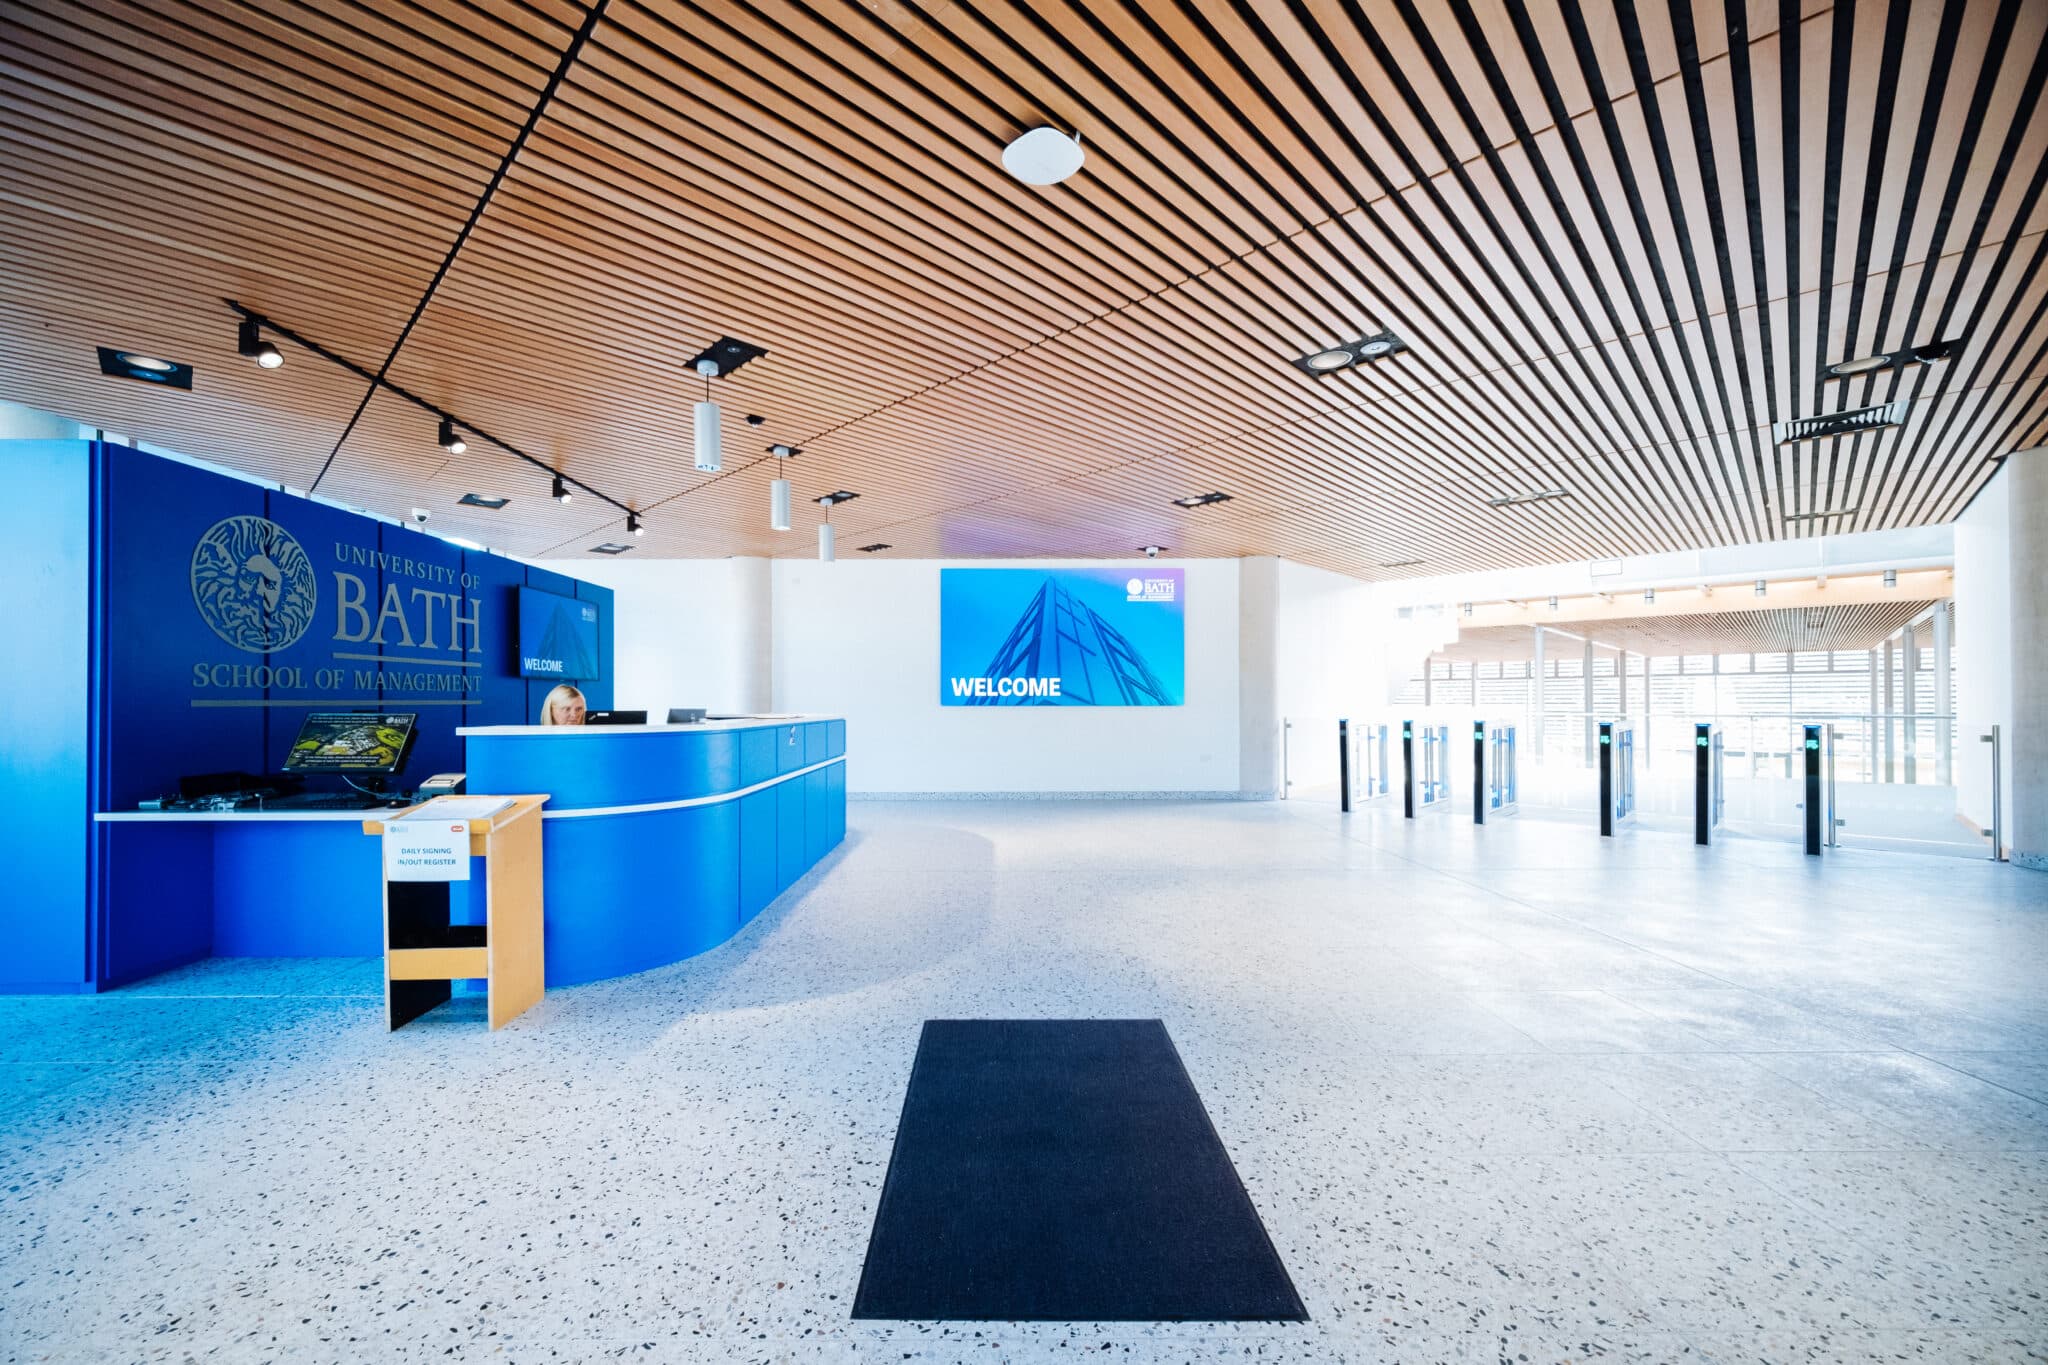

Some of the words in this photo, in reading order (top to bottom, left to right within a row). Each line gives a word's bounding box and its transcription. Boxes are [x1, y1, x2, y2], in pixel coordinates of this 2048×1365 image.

[335, 543, 456, 584] UNIVERSITY
[461, 573, 480, 590] OF
[1144, 582, 1175, 593] BATH
[332, 571, 482, 653] BATH
[524, 657, 563, 672] WELCOME
[192, 663, 308, 689] SCHOOL
[315, 669, 345, 690] OF
[353, 671, 482, 692] MANAGEMENT
[951, 677, 1061, 697] WELCOME
[401, 847, 421, 855] DAILY
[422, 847, 452, 855] SIGNING
[398, 858, 422, 866] IN/OUT
[424, 858, 457, 866] REGISTER
